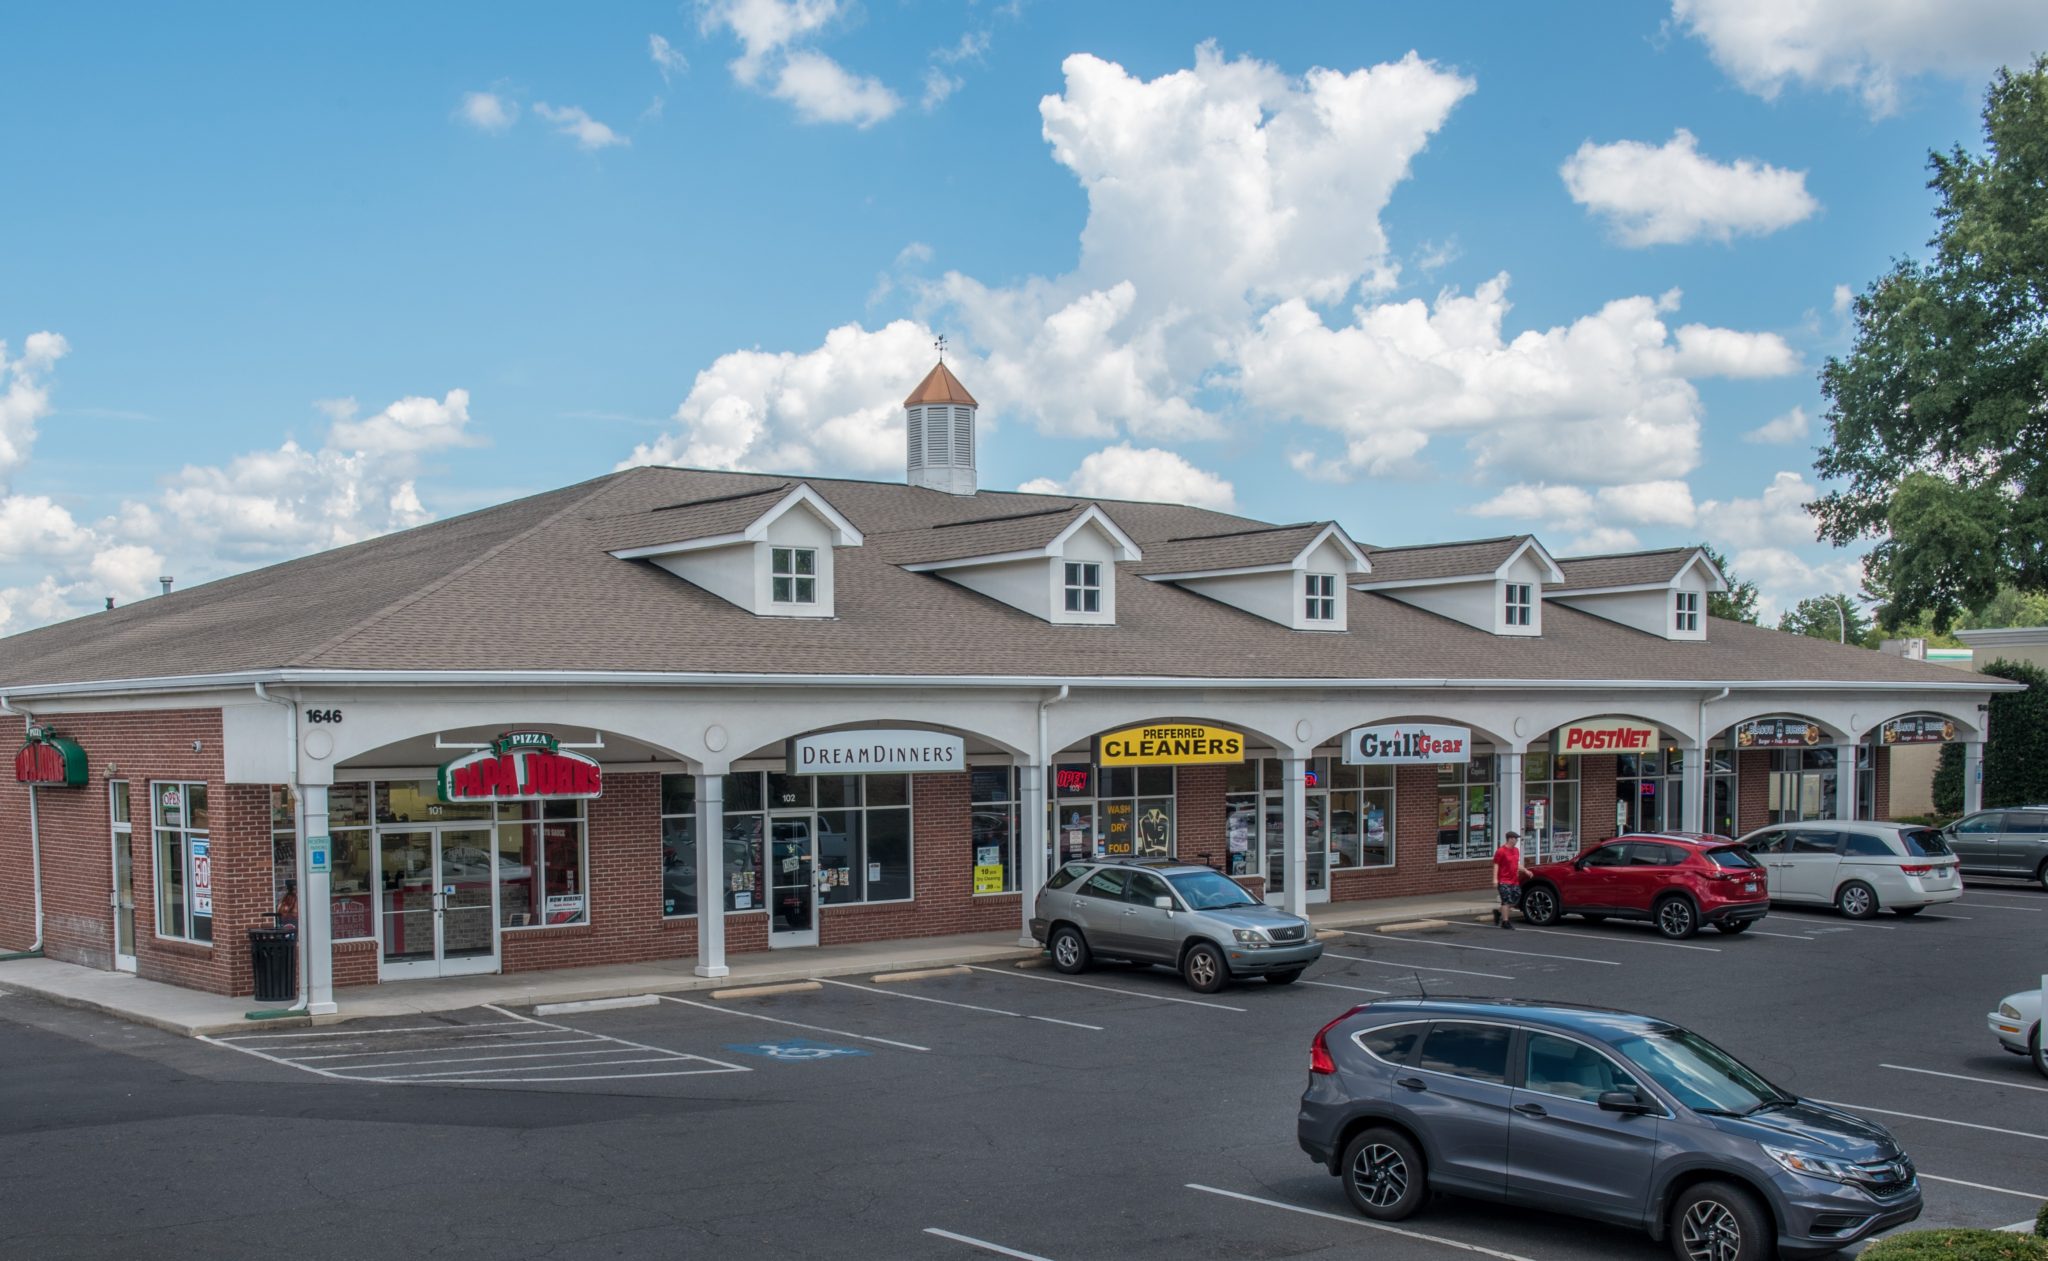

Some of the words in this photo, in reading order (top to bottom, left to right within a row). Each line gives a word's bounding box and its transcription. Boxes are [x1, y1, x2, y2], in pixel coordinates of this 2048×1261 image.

[306, 709, 343, 723] 1646
[512, 733, 547, 745] PIZZA
[1143, 728, 1205, 739] PREFERRED
[1105, 739, 1240, 757] CLEANERS
[453, 754, 520, 797] PAPA
[1056, 770, 1087, 789] OPEN
[783, 794, 796, 802] 102
[428, 807, 443, 815] 101
[1107, 804, 1131, 814] WASH
[1110, 823, 1127, 832] DRY
[1109, 844, 1130, 853] FOLD
